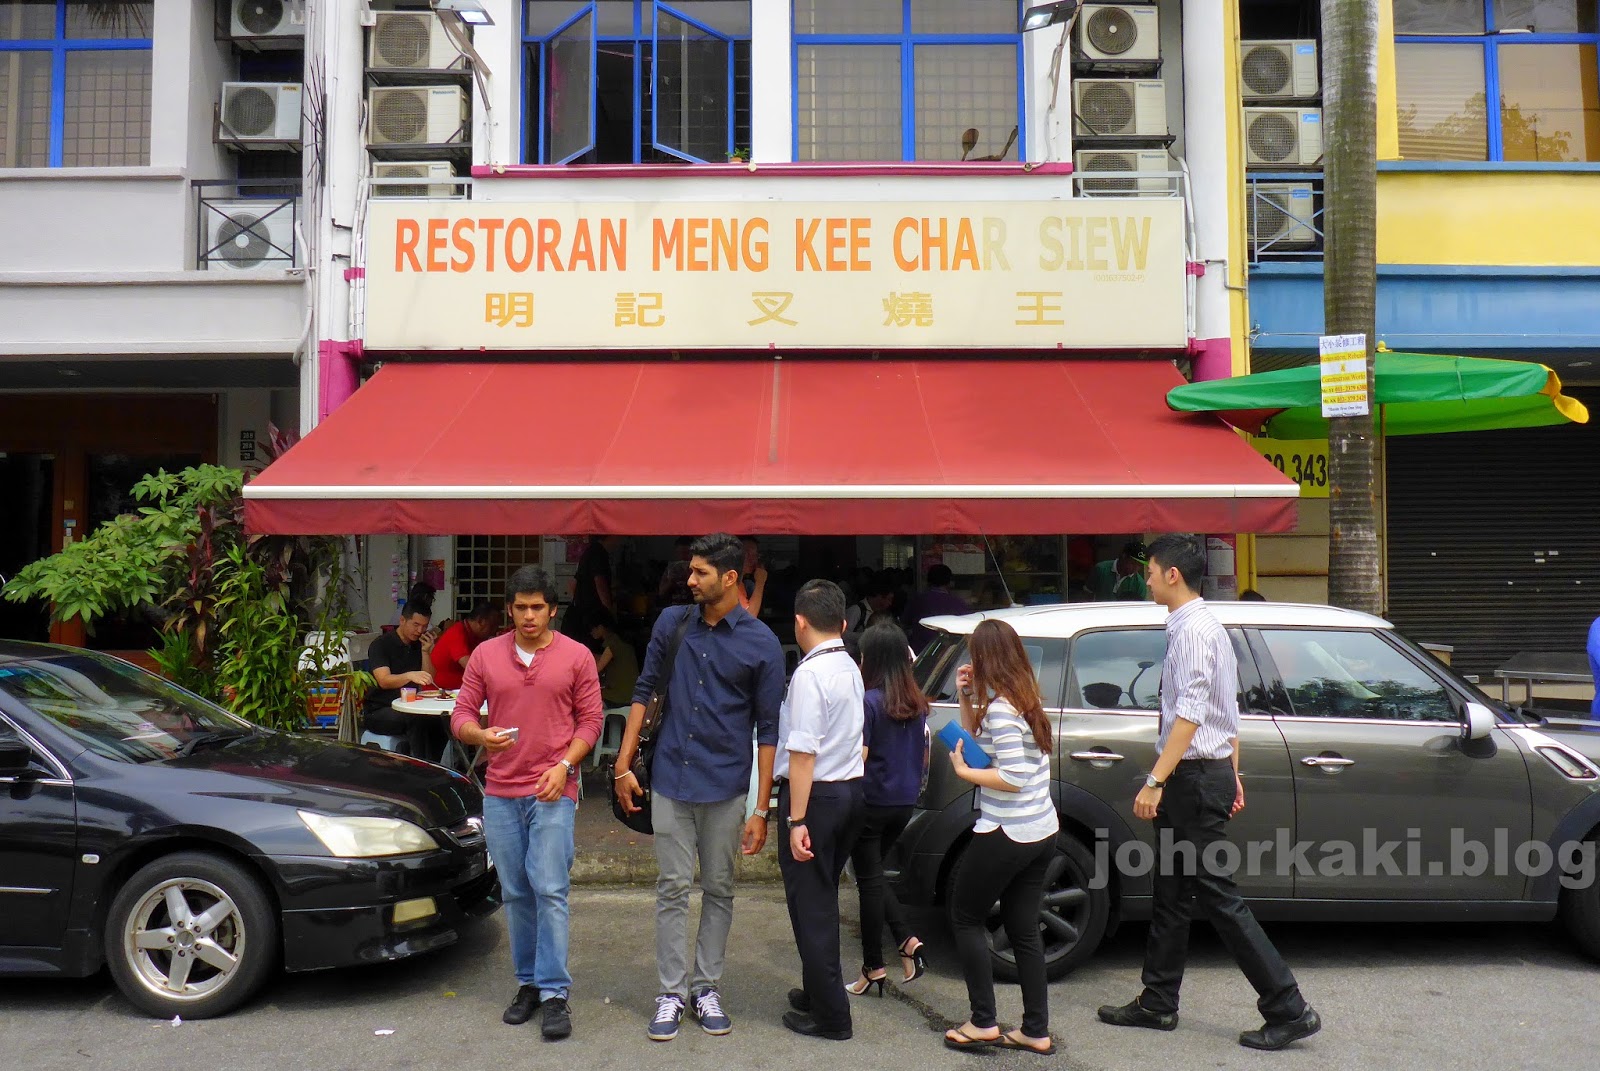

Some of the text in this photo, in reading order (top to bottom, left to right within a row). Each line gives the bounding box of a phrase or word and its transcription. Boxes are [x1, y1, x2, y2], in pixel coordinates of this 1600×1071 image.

[395, 216, 1152, 273] RESTORAN MENG KEE CHAR SIEW
